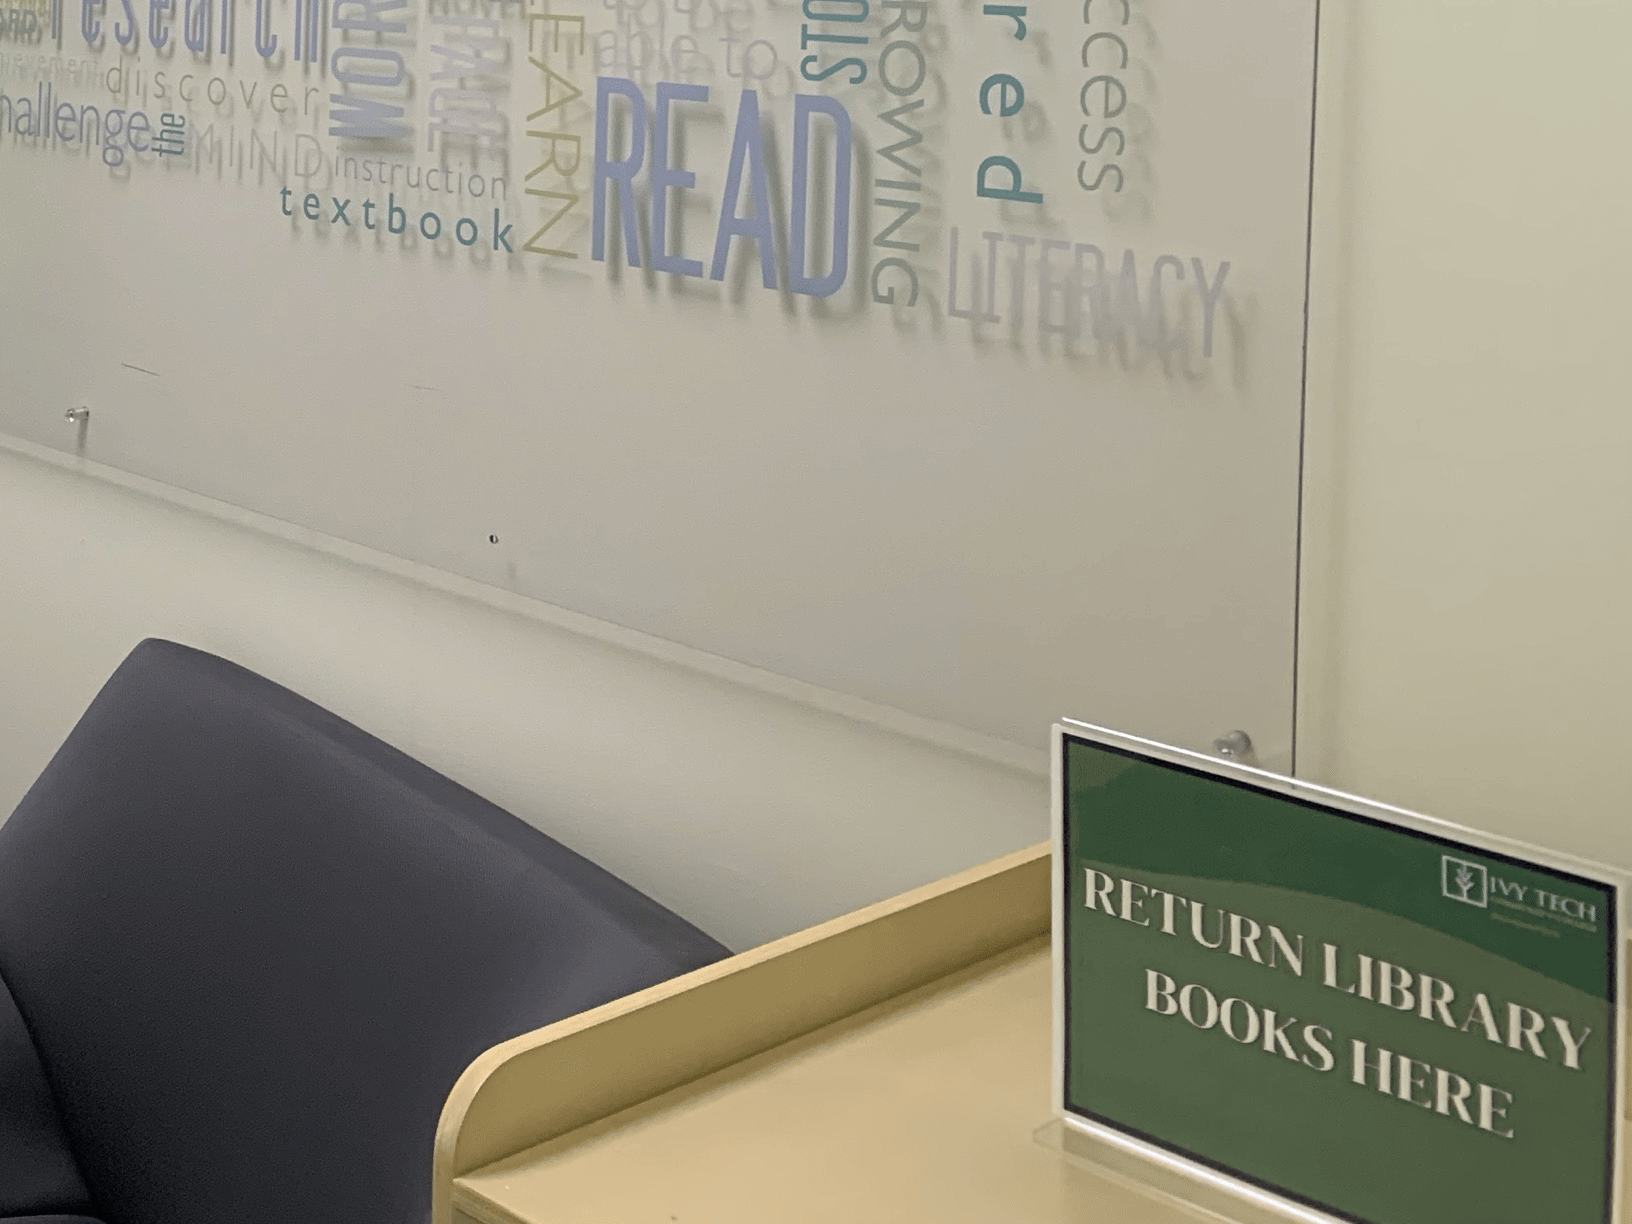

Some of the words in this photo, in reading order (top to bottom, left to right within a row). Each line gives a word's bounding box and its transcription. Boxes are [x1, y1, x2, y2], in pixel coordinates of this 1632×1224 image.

[106, 55, 320, 115] discover
[151, 112, 185, 158] the
[190, 122, 322, 178] MIND
[335, 146, 507, 201] instruction
[591, 75, 852, 298] READ
[280, 186, 514, 254] textbook
[947, 226, 1231, 358] LITERACY
[1490, 876, 1528, 902] IVY
[1534, 889, 1596, 922] TECH
[1083, 867, 1305, 977] RETURN
[1322, 943, 1592, 1071] LIBRARY
[1144, 968, 1335, 1072] BOOKS
[1350, 1038, 1514, 1139] HERE
